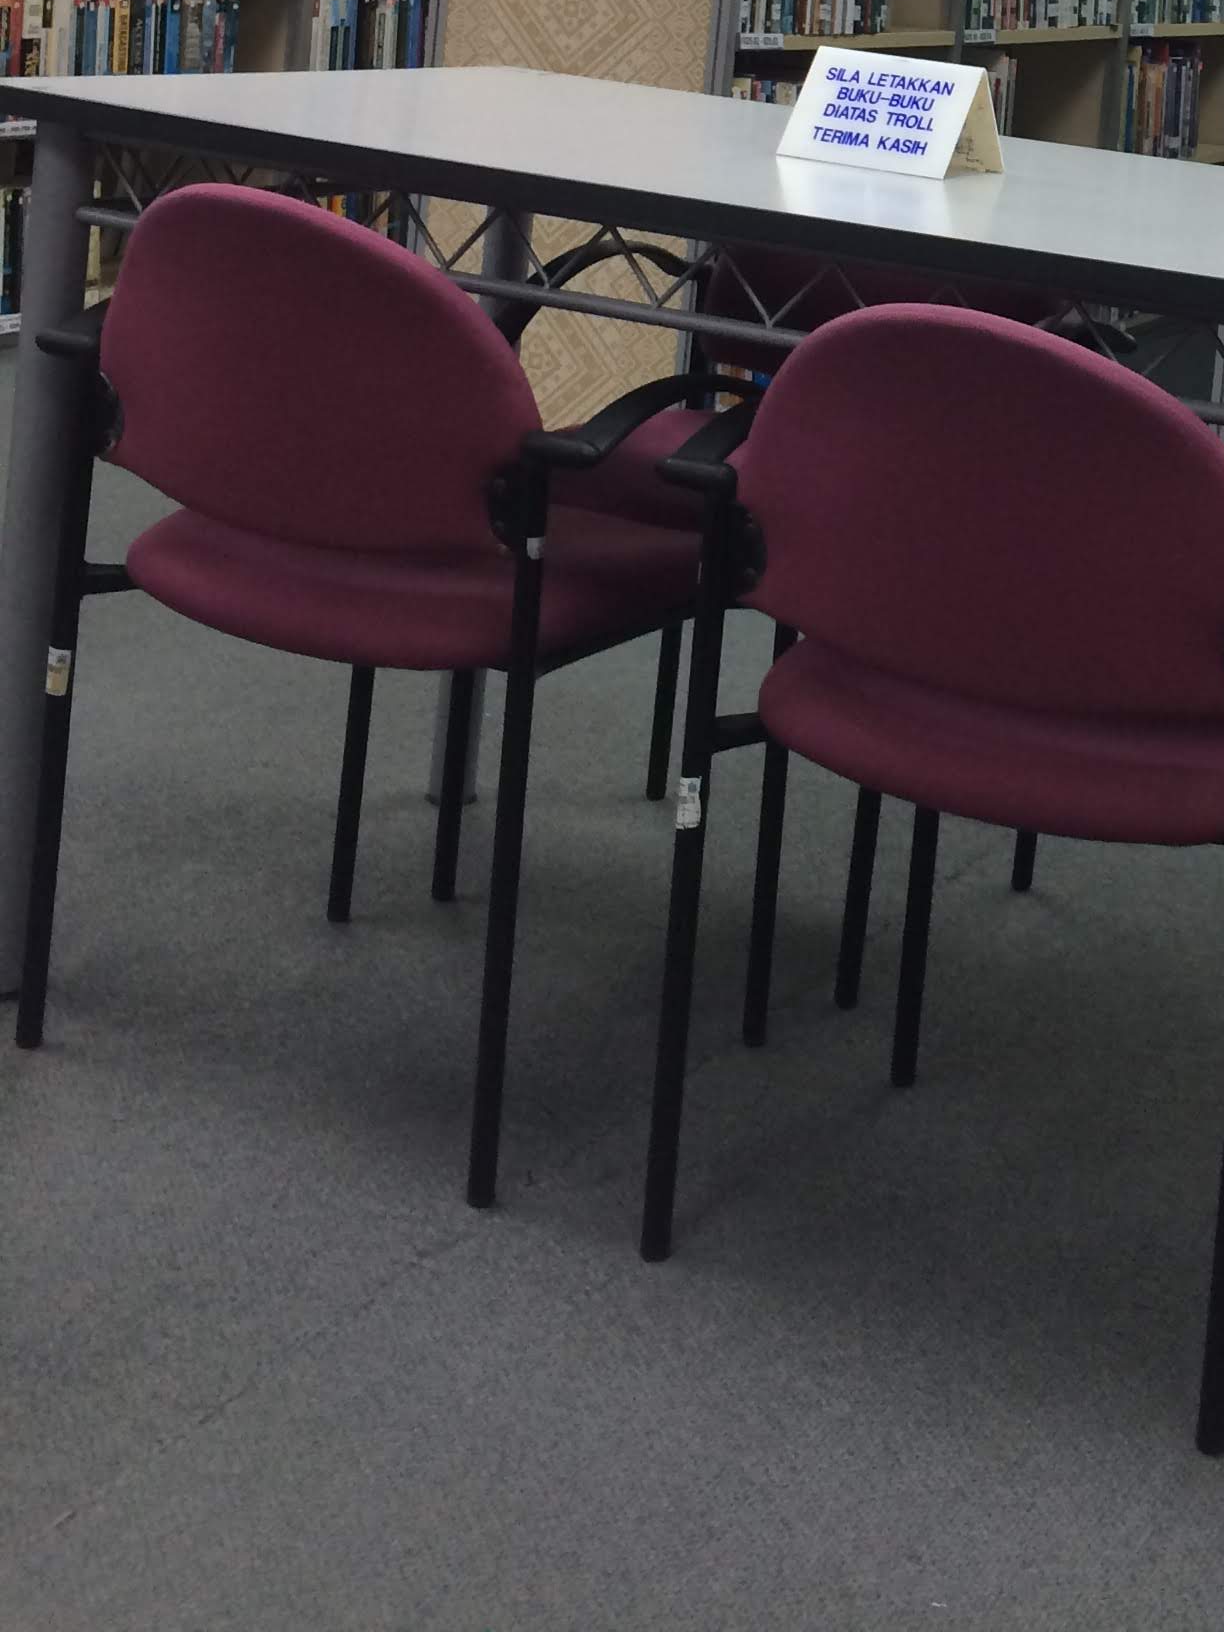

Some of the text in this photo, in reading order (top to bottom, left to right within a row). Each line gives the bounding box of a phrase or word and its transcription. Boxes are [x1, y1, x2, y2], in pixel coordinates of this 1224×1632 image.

[826, 67, 955, 96] SILA LETAKKAN
[837, 87, 936, 112] BUKU-BUKU
[823, 103, 878, 124] DIATAS
[813, 126, 928, 156] TERIMA KASIH
